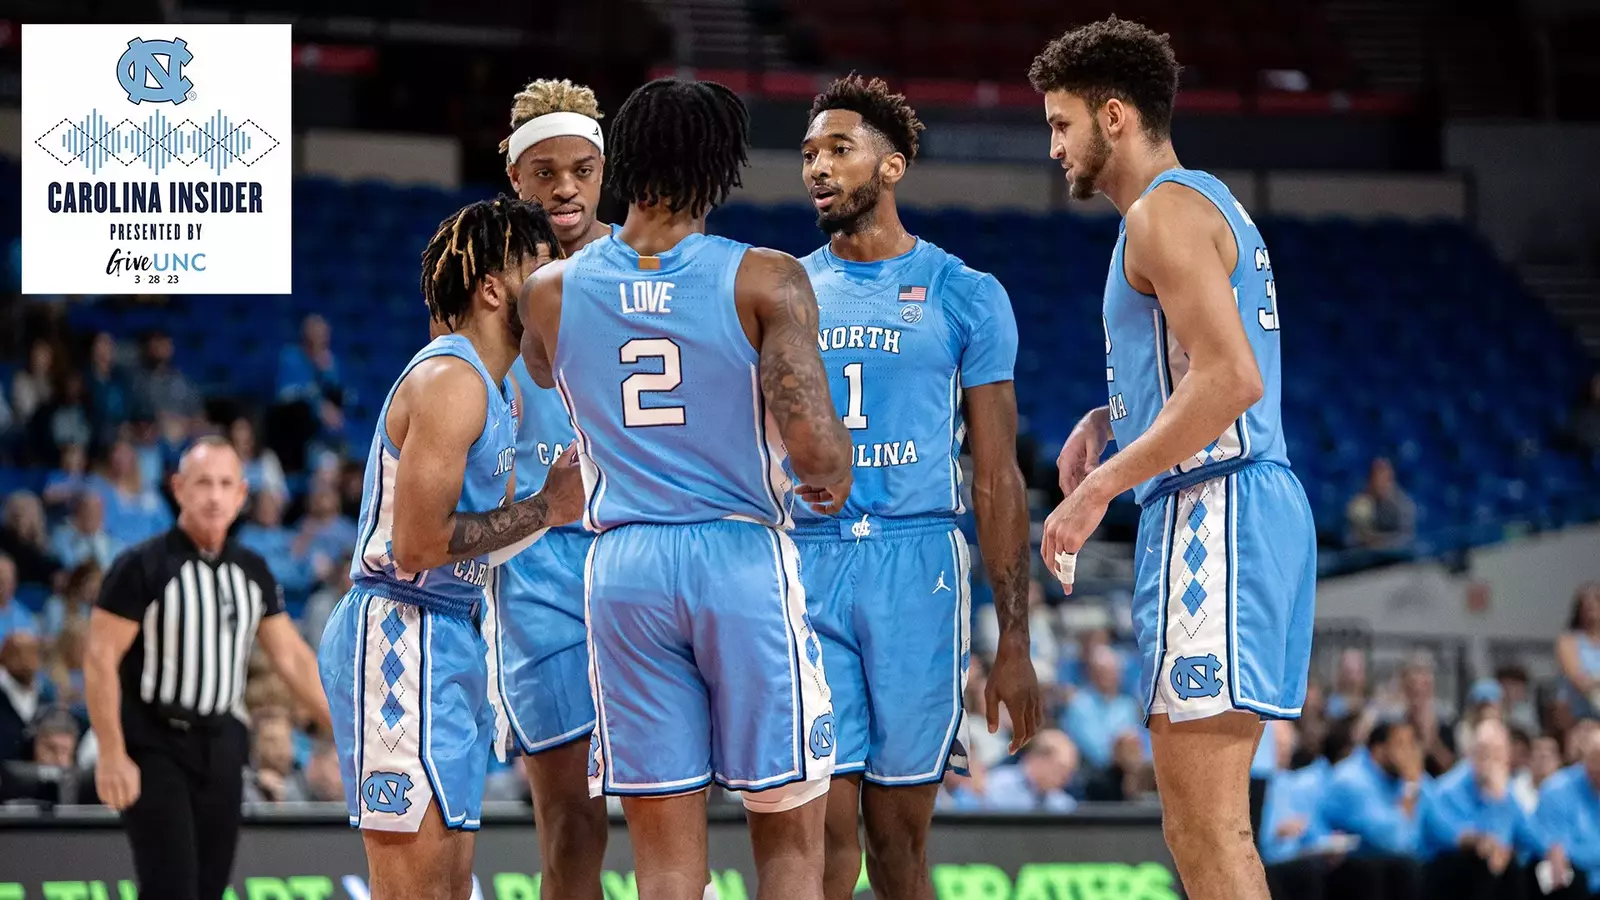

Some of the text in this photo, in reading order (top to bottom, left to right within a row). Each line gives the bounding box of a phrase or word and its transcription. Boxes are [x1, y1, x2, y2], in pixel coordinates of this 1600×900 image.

[619, 280, 675, 314] LOVE
[817, 325, 902, 354] NORTH
[618, 337, 687, 428] 2
[842, 362, 868, 430] 1
